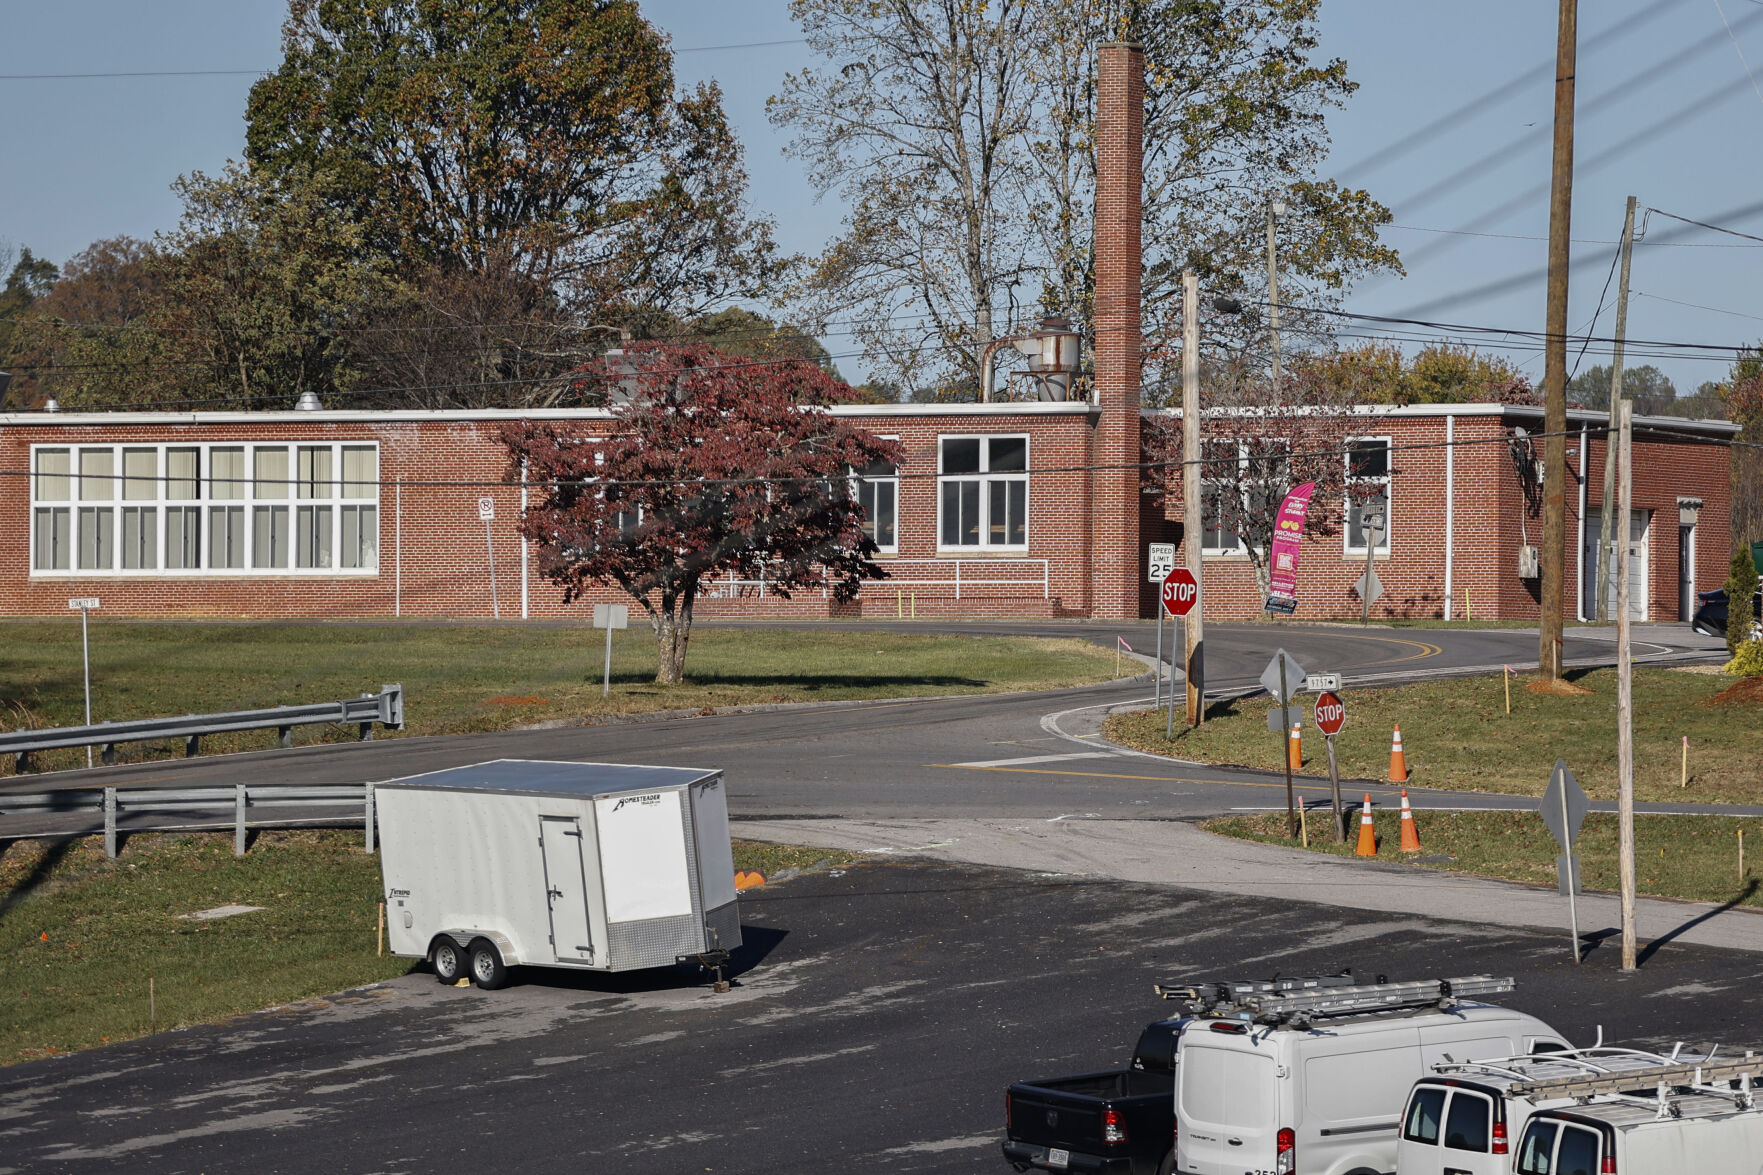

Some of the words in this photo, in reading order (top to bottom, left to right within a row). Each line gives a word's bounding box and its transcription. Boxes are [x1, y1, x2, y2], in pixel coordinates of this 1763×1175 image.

[1275, 530, 1302, 539] PROMISE
[1150, 564, 1171, 578] 25
[1163, 582, 1196, 602] STOP
[1317, 704, 1342, 723] STOP
[612, 794, 661, 812] HOMESTEADER
